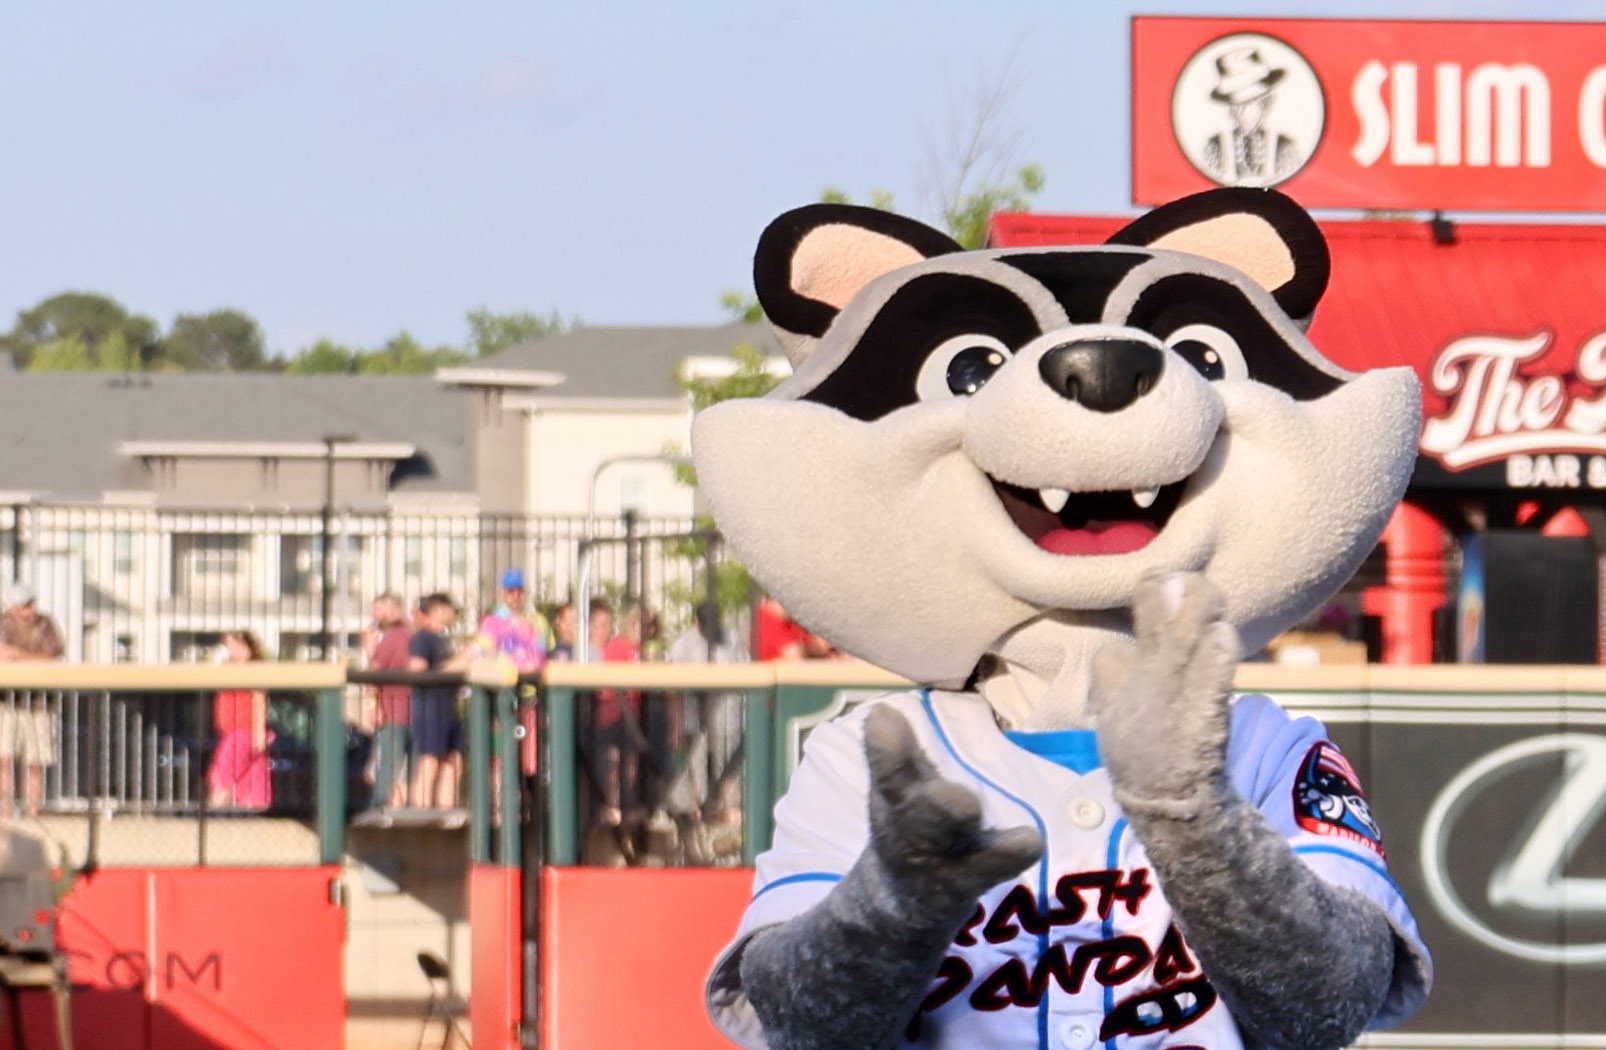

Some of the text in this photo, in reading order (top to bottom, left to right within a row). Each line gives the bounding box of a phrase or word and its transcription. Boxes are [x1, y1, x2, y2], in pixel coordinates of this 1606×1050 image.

[1350, 59, 1551, 167] SLIM
[1420, 332, 1563, 452] The
[1507, 455, 1581, 489] BAR
[953, 867, 1152, 947] ASH
[906, 921, 1197, 1043] PANDA
